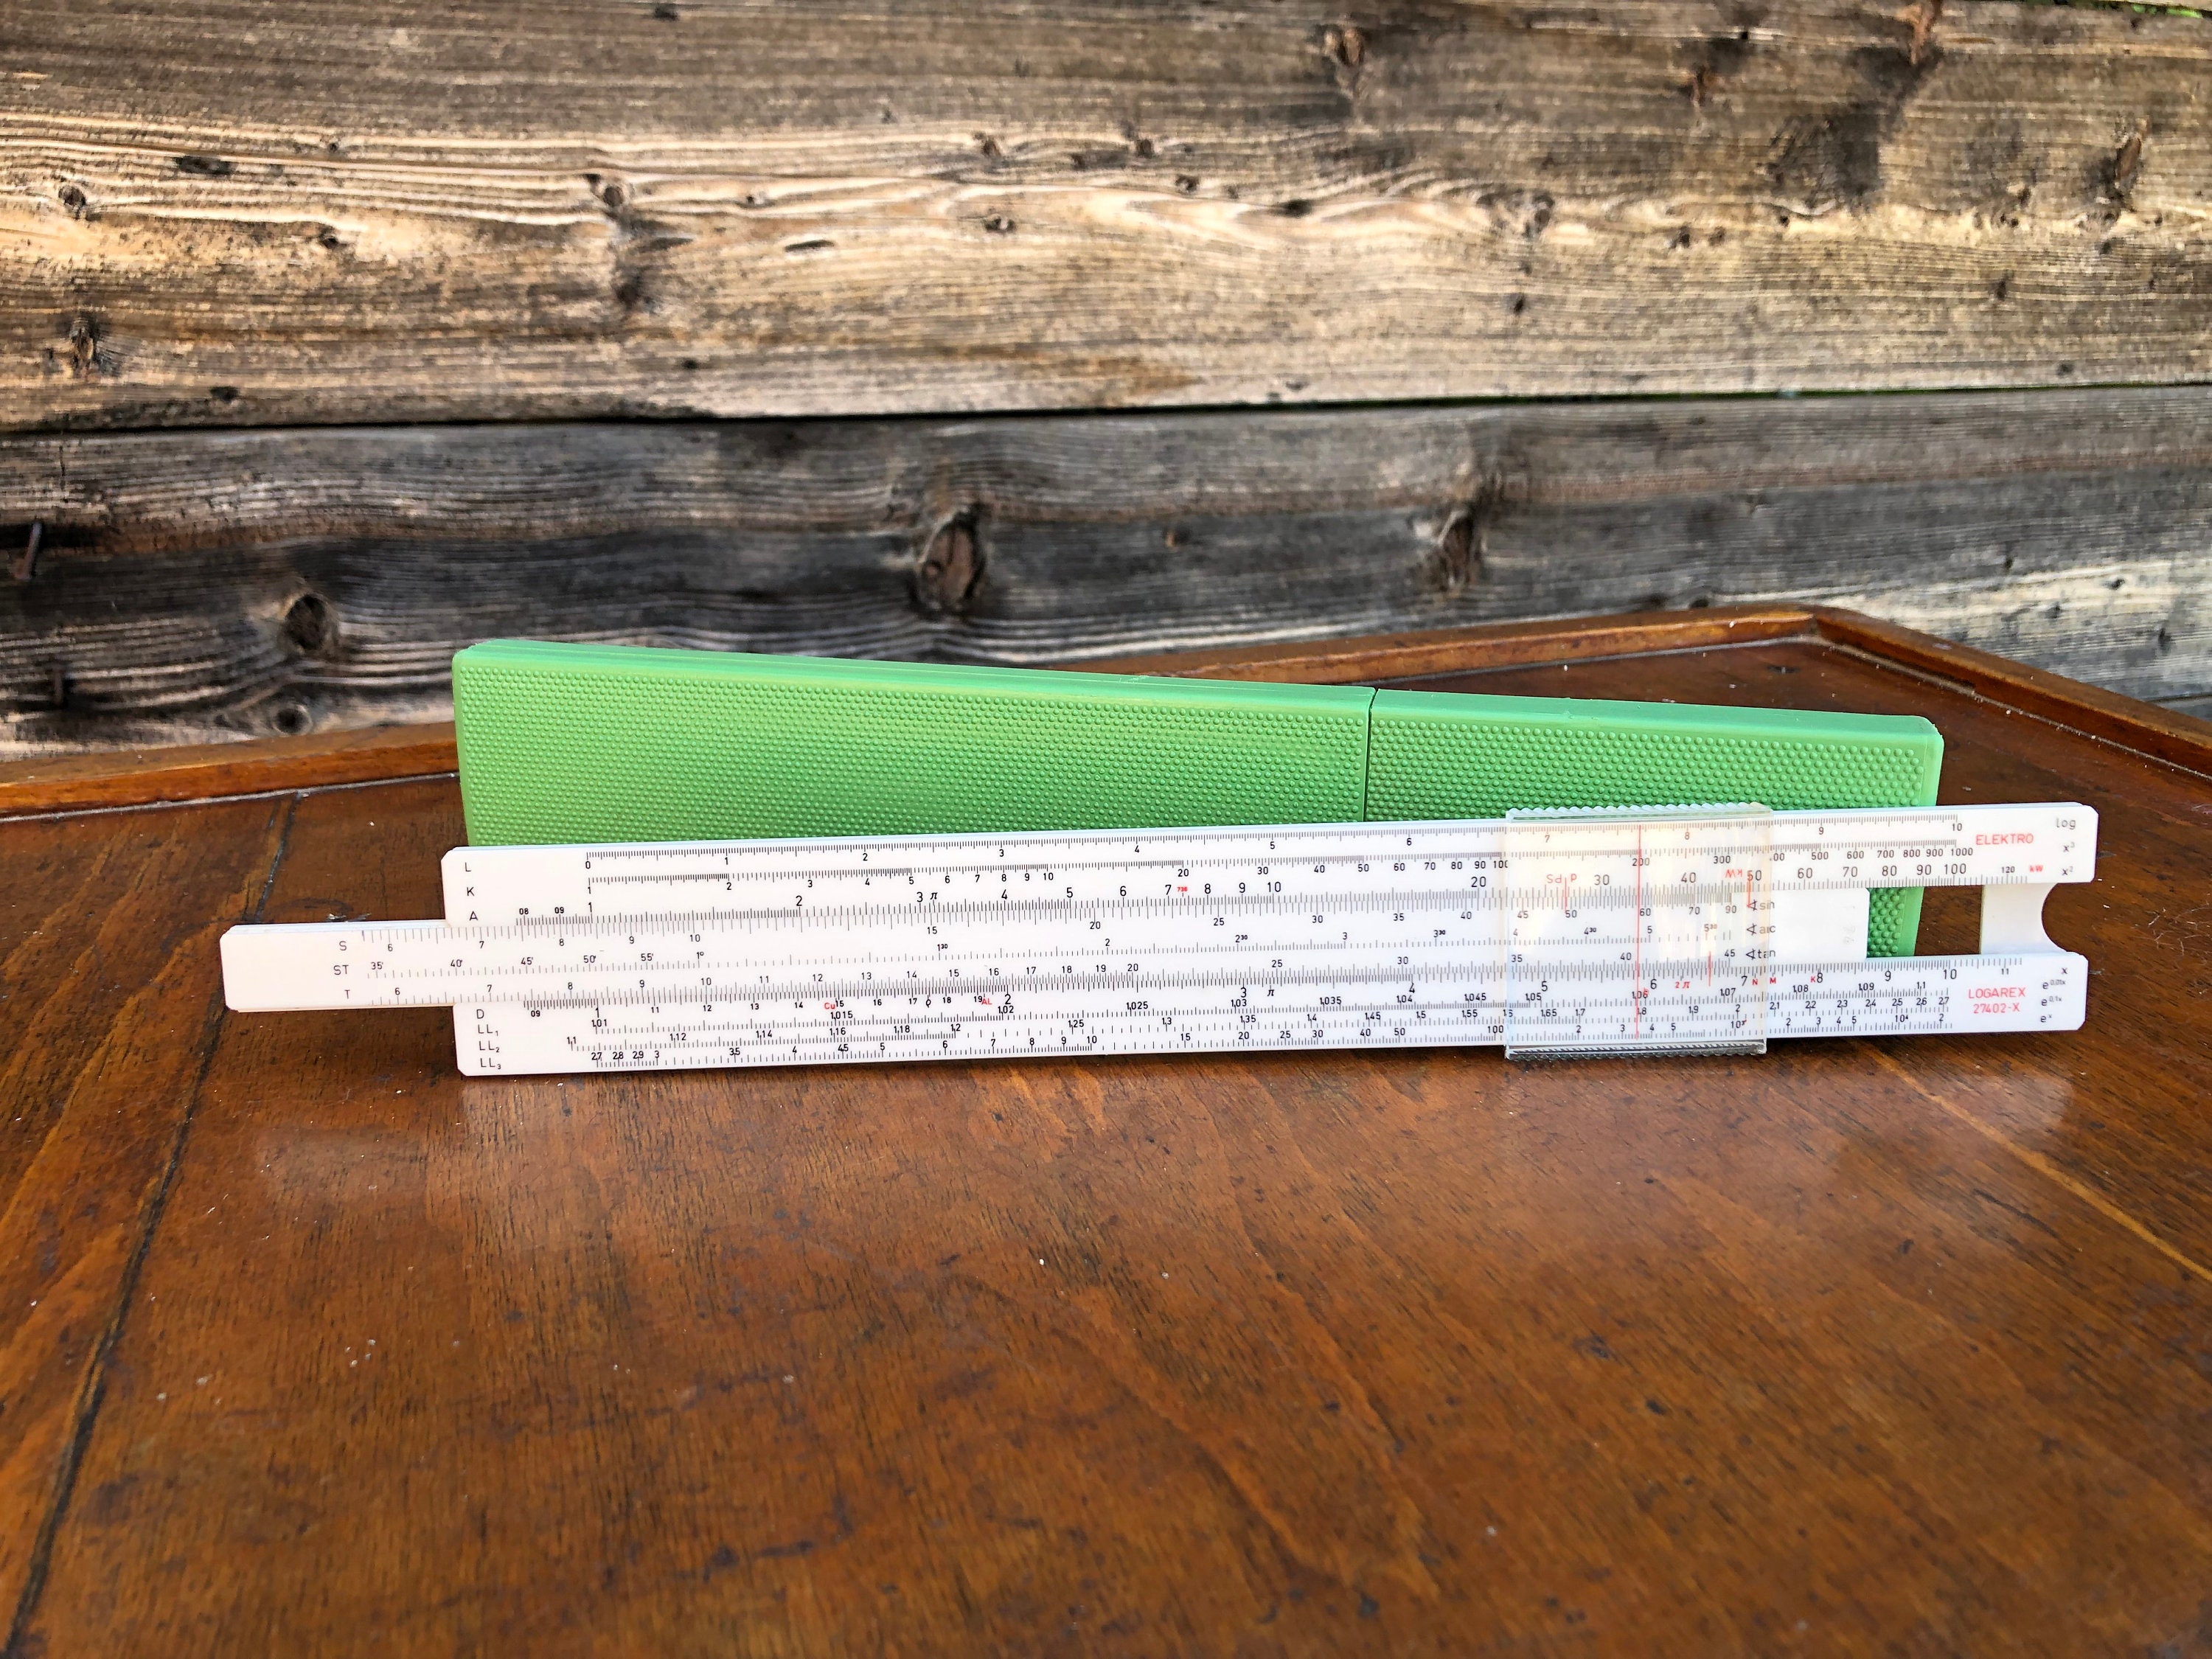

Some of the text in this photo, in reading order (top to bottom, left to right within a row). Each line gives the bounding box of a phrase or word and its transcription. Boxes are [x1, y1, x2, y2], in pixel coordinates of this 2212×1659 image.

[465, 818, 2076, 872] L 0 2 3 4 5 6 7 8 9 10 log
[1976, 833, 2034, 846] ELEKTRO
[467, 887, 475, 897] K
[1043, 872, 1054, 881] 10
[1178, 869, 1189, 877] 20
[1257, 866, 1269, 874] 30
[1314, 865, 1325, 874] 40
[1357, 863, 1369, 872] 50
[1394, 863, 1405, 872] 60
[1424, 862, 1436, 870] 70
[1451, 861, 1463, 869] 80
[1474, 860, 1486, 869] 90
[1632, 858, 1650, 866] 200
[1714, 855, 1731, 864] 300
[1811, 852, 1829, 860] 500
[1846, 850, 1865, 859] 600
[1877, 849, 1895, 858] 700
[1903, 849, 1921, 858] 800
[1926, 848, 1944, 857] 900
[1951, 847, 1973, 856] 1000
[469, 911, 479, 921] A
[519, 907, 529, 915] 08
[554, 906, 565, 914] 09
[796, 895, 803, 906] 2
[917, 891, 923, 902] 3
[1001, 889, 1008, 900] 4
[1066, 887, 1073, 898] 5
[1120, 886, 1127, 897] 6
[1165, 884, 1172, 895] 7
[1204, 883, 1211, 894] 8
[1239, 883, 1246, 894] 9
[1267, 881, 1281, 892] 10
[1471, 876, 1486, 887] 20
[1594, 874, 1610, 886] 30
[1681, 872, 1697, 883] 40
[1747, 870, 1762, 881] 50
[1797, 868, 1813, 879] 60
[1843, 866, 1858, 877] 70
[1882, 865, 1897, 876] 80
[1916, 864, 1932, 875] 90
[1944, 863, 1966, 874] 100
[2001, 866, 2015, 874] 120
[339, 941, 347, 951] S
[690, 934, 700, 942] 10
[927, 926, 937, 934] 15
[1090, 922, 1101, 930] 20
[1213, 917, 1225, 926] 25
[1312, 915, 1324, 923] 30
[1393, 913, 1405, 922] 35
[1461, 911, 1472, 919] 40
[1517, 911, 1528, 919] 45
[1565, 910, 1577, 918] 50
[1640, 908, 1652, 917] 60
[1688, 906, 1700, 915] 70
[1725, 905, 1736, 914] 90
[333, 965, 349, 975] ST
[344, 990, 350, 999] T
[700, 977, 712, 986] 10
[759, 975, 769, 984] 11
[813, 973, 823, 982] 12
[907, 970, 917, 978] 14
[949, 969, 959, 977] 15
[989, 968, 999, 976] 16
[1026, 966, 1037, 975] 17
[1062, 965, 1072, 974] 18
[1096, 964, 1106, 973] 19
[1127, 964, 1138, 972] 20
[1271, 960, 1283, 968] 25
[1397, 956, 1408, 965] 30
[1512, 954, 1523, 963] 35
[1620, 952, 1632, 961] 40
[1724, 950, 1736, 958] 45
[1968, 987, 2026, 999] LOGAREX
[476, 1009, 484, 1019] D
[703, 1004, 712, 1012] 12
[873, 998, 882, 1006] 16
[1004, 994, 1012, 1005] 2
[1240, 987, 1247, 998] 3
[1408, 983, 1415, 993] 4
[1541, 981, 1548, 992] 5
[1650, 978, 1658, 990] 6
[1741, 975, 1747, 987] 7
[1817, 973, 1823, 984] 8
[1885, 970, 1891, 981] 9
[1943, 969, 1957, 980] 10
[1973, 1003, 2020, 1014] 27402-X
[1087, 1035, 1097, 1044] 10
[1180, 1032, 1191, 1041] 15
[1239, 1032, 1250, 1040] 20
[1280, 1030, 1291, 1039] 25
[1312, 1029, 1324, 1038] 30
[1360, 1028, 1371, 1037] 40
[1394, 1028, 1405, 1036] 50
[1487, 1025, 1504, 1034] 100
